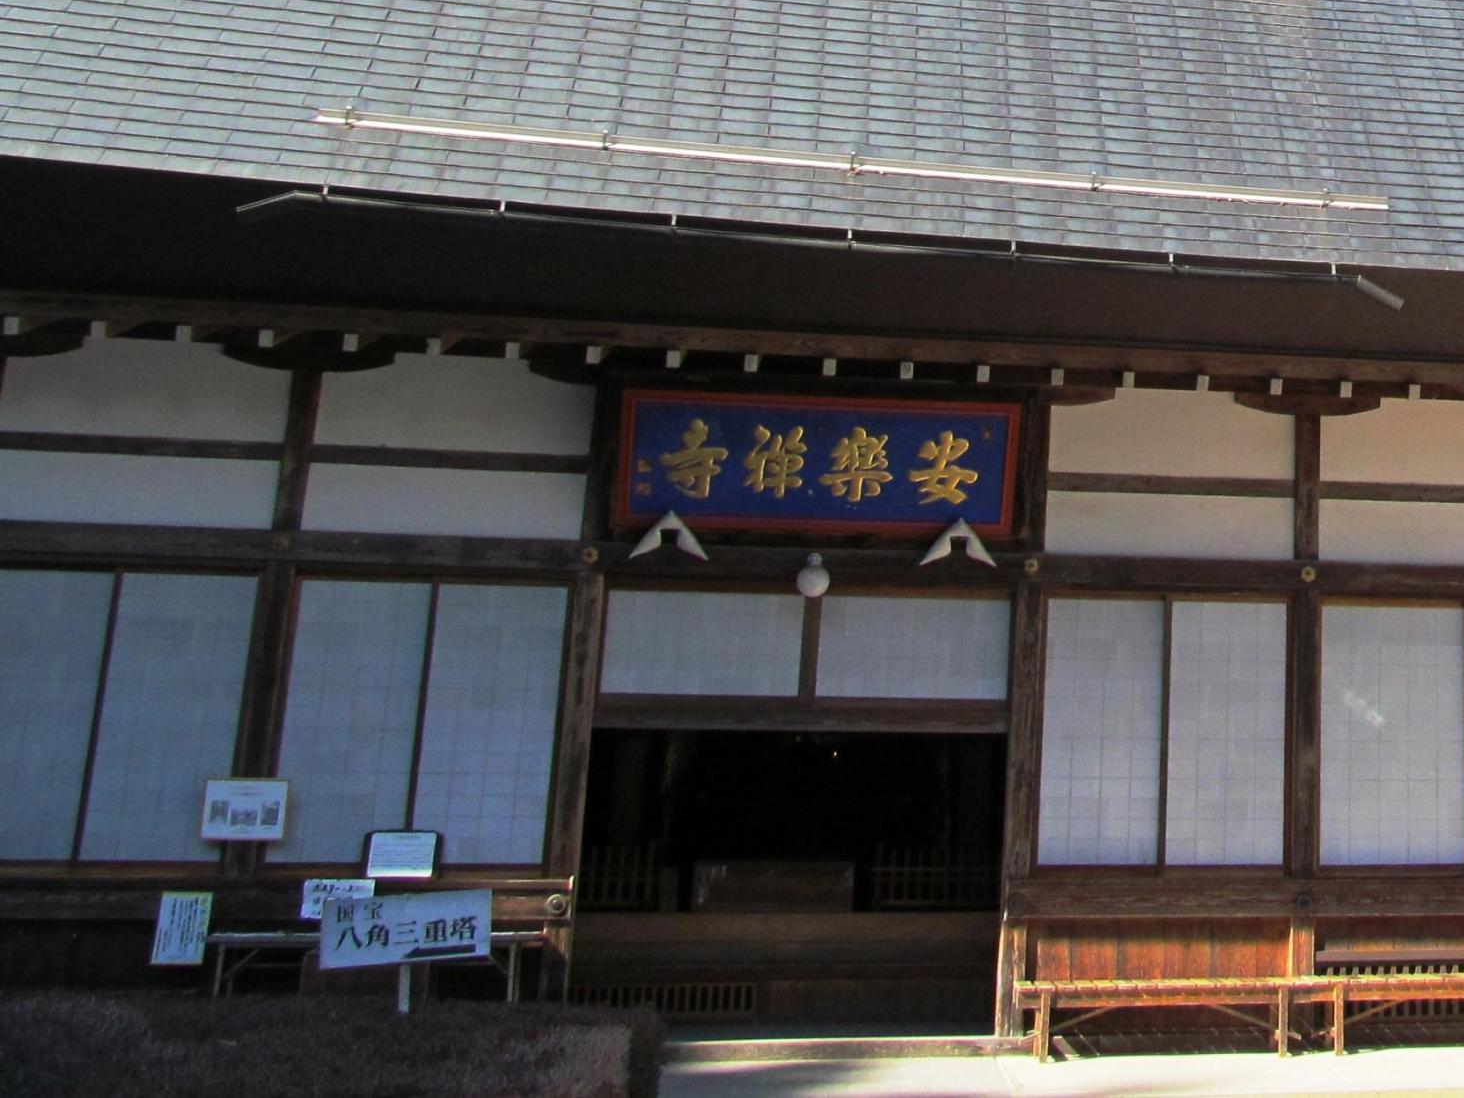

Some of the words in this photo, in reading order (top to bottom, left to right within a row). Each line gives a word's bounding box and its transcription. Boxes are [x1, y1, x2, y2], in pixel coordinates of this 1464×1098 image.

[337, 901, 384, 923] 国宝
[335, 916, 478, 951] 八角三重塔
